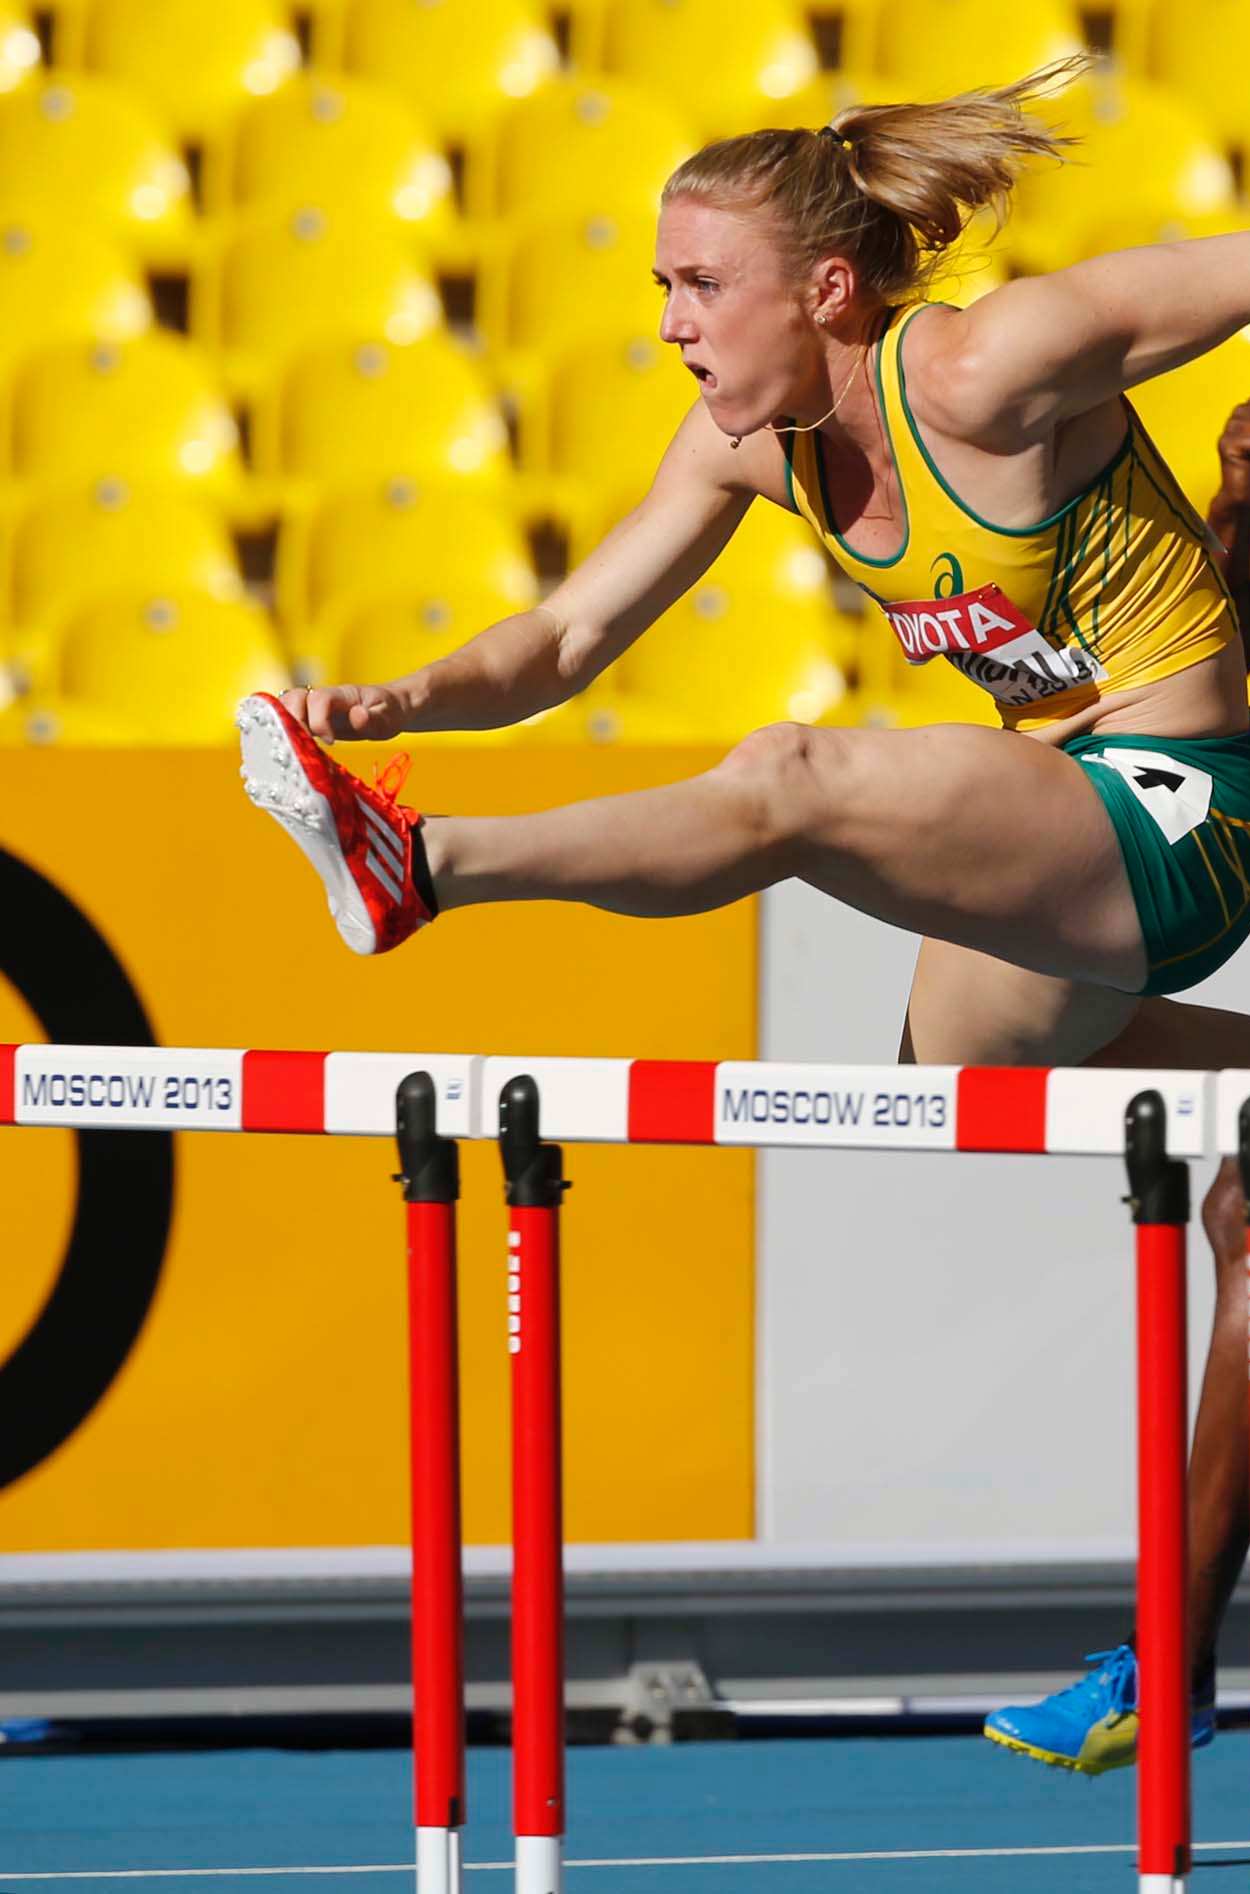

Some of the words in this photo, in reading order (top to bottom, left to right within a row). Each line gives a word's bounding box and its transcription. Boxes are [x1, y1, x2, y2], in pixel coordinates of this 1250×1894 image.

[886, 602, 1015, 654] OYOTA
[22, 1073, 156, 1110] MOSCOW
[163, 1077, 233, 1110] 2013
[722, 1088, 865, 1125] MOSCOW
[873, 1092, 946, 1127] 2013
